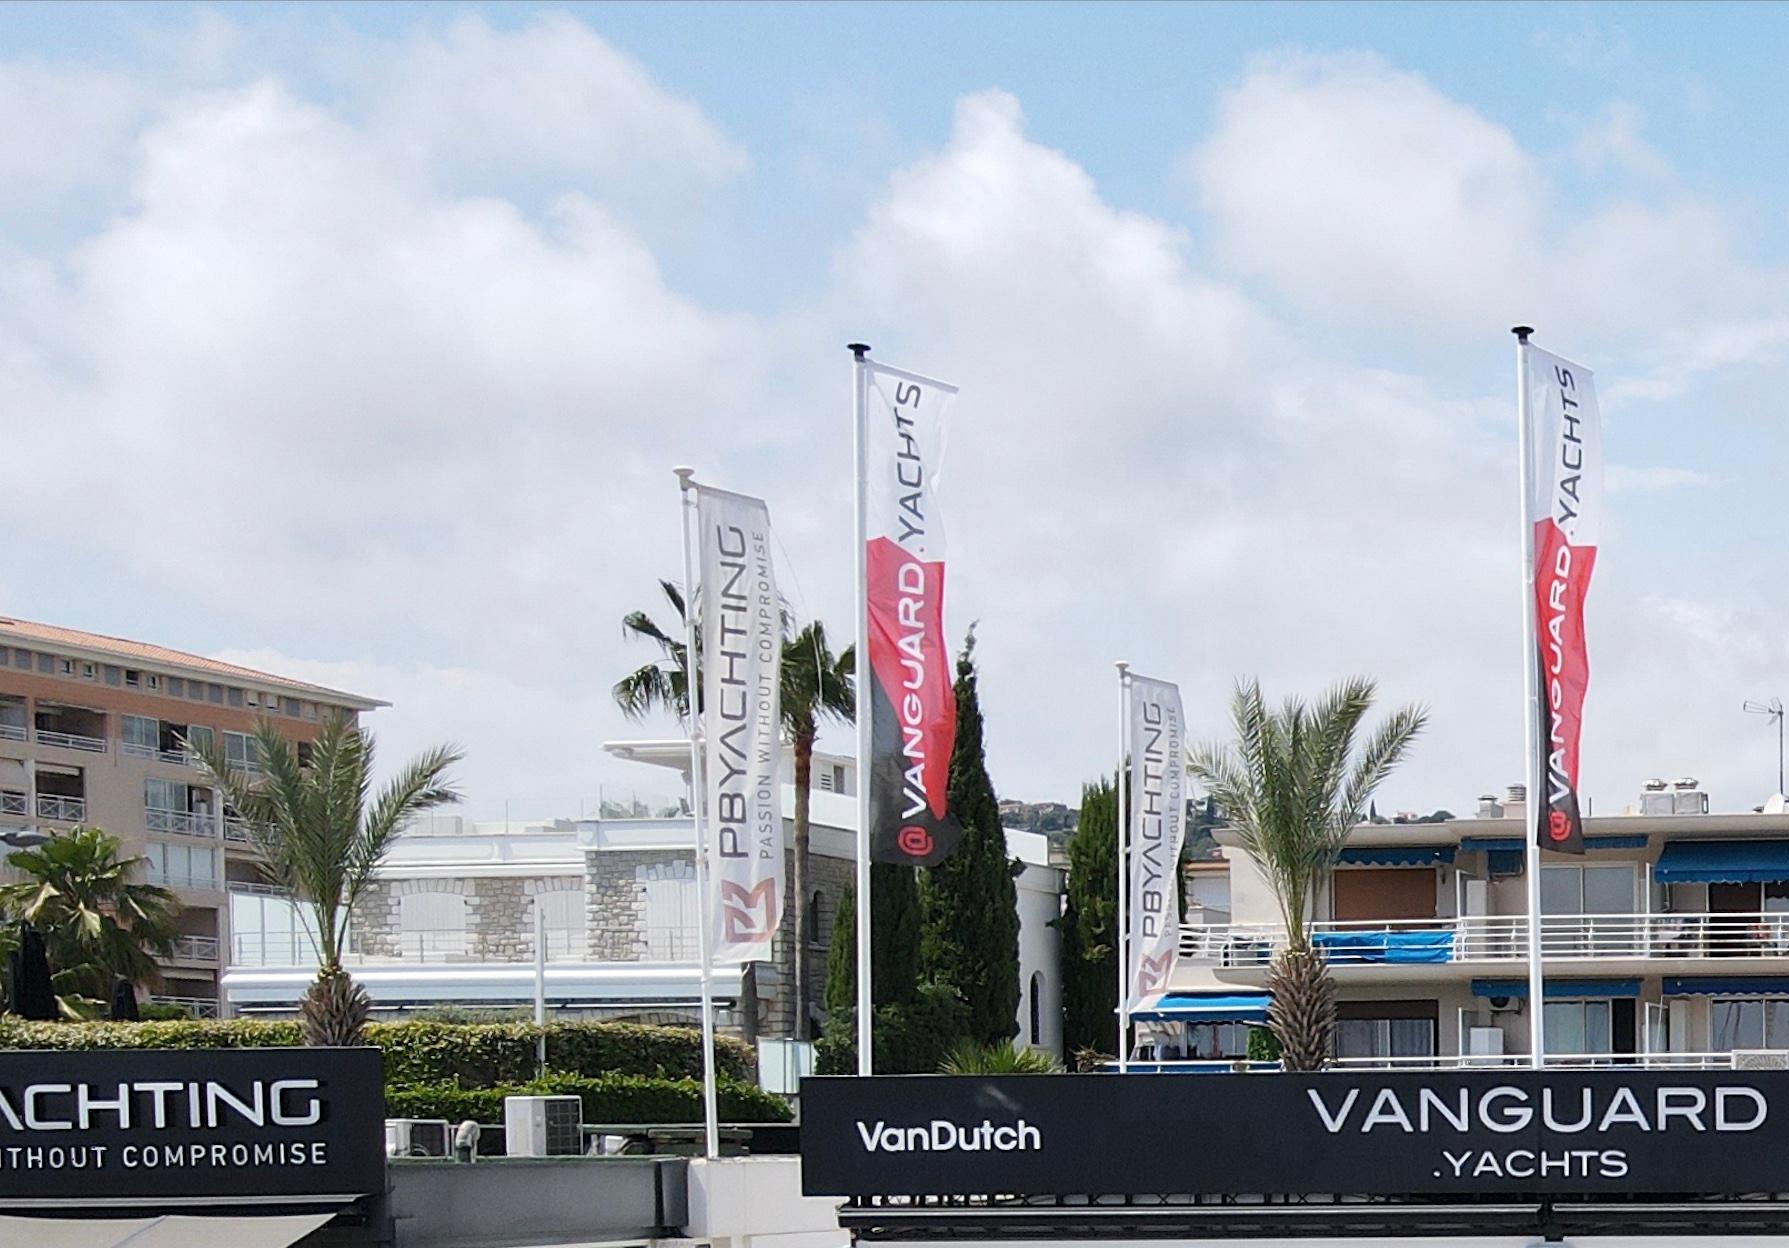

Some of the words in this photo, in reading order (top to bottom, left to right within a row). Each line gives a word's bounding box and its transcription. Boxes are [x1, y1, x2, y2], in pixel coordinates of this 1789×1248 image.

[752, 531, 773, 663] COMPROMISE
[716, 525, 748, 859] PBYACHTING
[757, 674, 772, 763] WITHOUT
[756, 774, 774, 859] PASSION
[1142, 701, 1162, 939] PBYACHTING
[856, 1119, 1041, 1153] VanDutch
[1307, 1086, 1769, 1134] VANGUARD
[123, 1142, 327, 1168] COMPROMISE
[1432, 1150, 1629, 1178] .YACHTS
